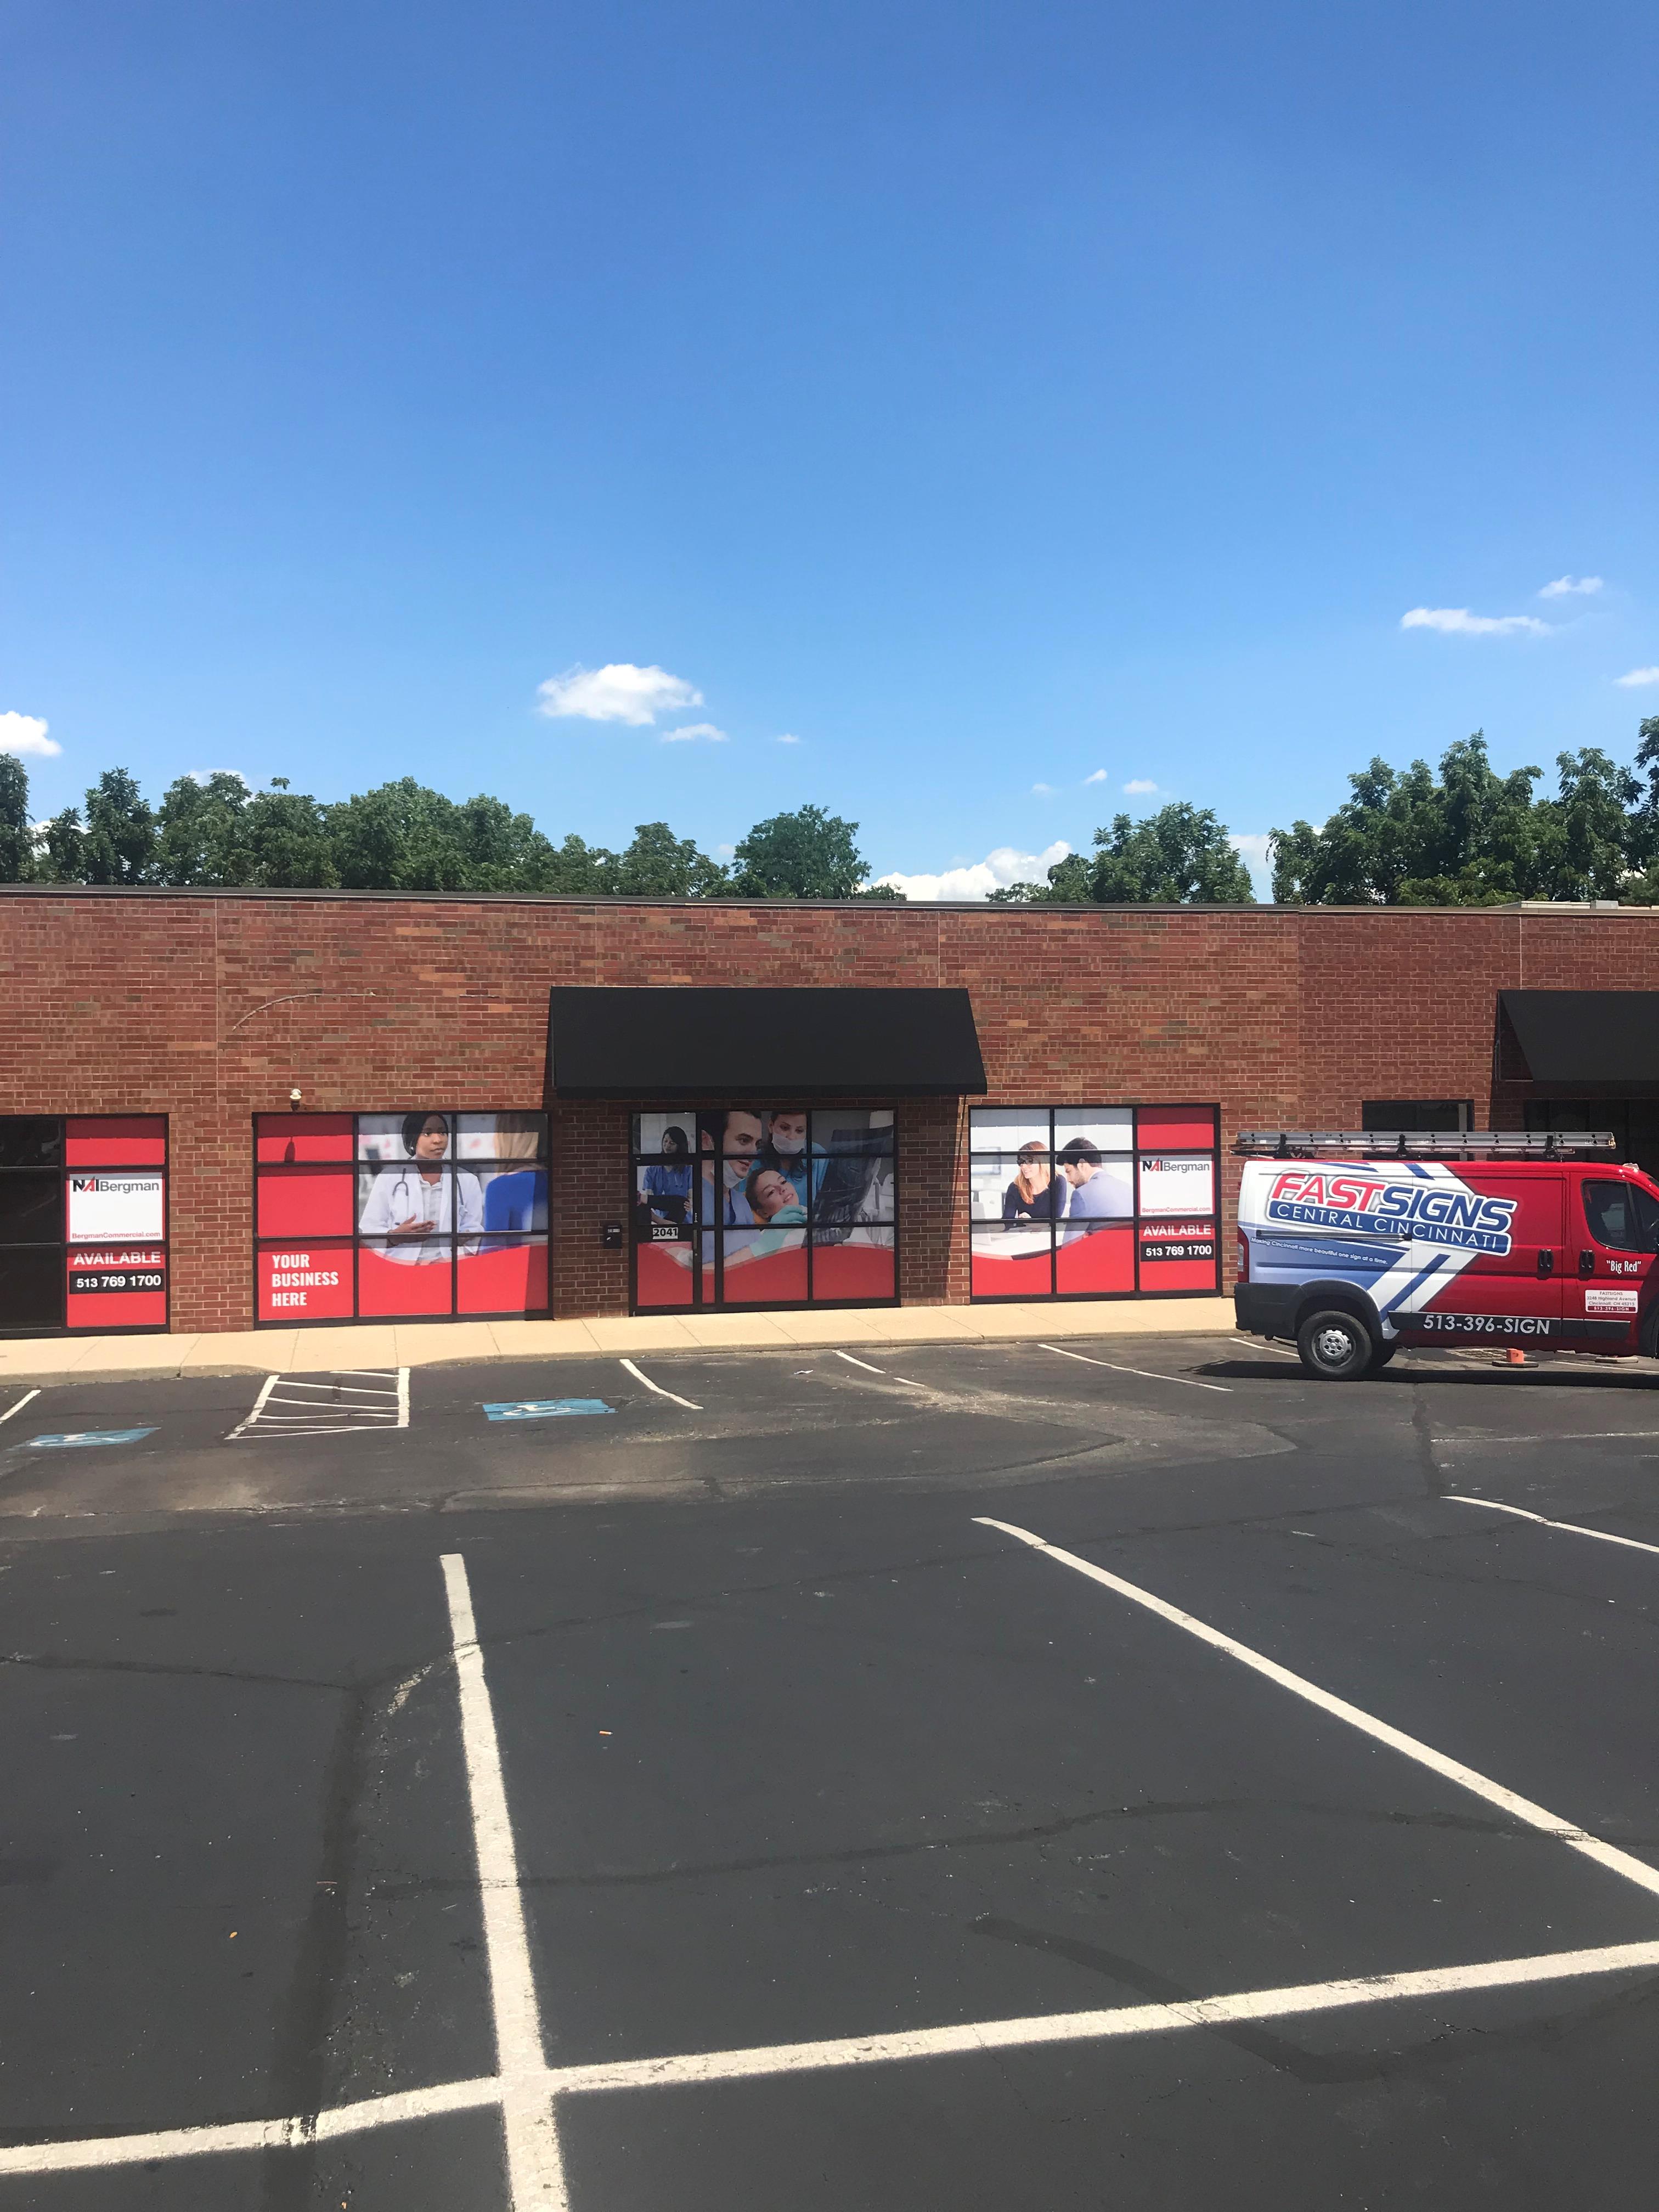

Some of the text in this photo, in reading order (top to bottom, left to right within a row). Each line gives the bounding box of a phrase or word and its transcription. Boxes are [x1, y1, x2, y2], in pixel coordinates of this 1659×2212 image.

[1272, 1173, 1515, 1232] FASTSIGNS
[653, 1228, 678, 1237] 2041
[1143, 1224, 1211, 1237] AVAILABLE
[1277, 1204, 1496, 1249] CENTRAL CINCINNATI
[1146, 1245, 1212, 1256] 513 769 1700
[1251, 1237, 1271, 1246] Making
[1271, 1240, 1299, 1250] Cincinnati
[1314, 1248, 1338, 1257] beautiful
[73, 1251, 161, 1265] AVAILABLE
[272, 1254, 310, 1268] YOUR
[76, 1275, 161, 1288] 513 769 1700
[272, 1271, 339, 1287] BUSINESS
[272, 1292, 307, 1306] HERE
[1423, 1314, 1550, 1334] 513-396-SIGN
